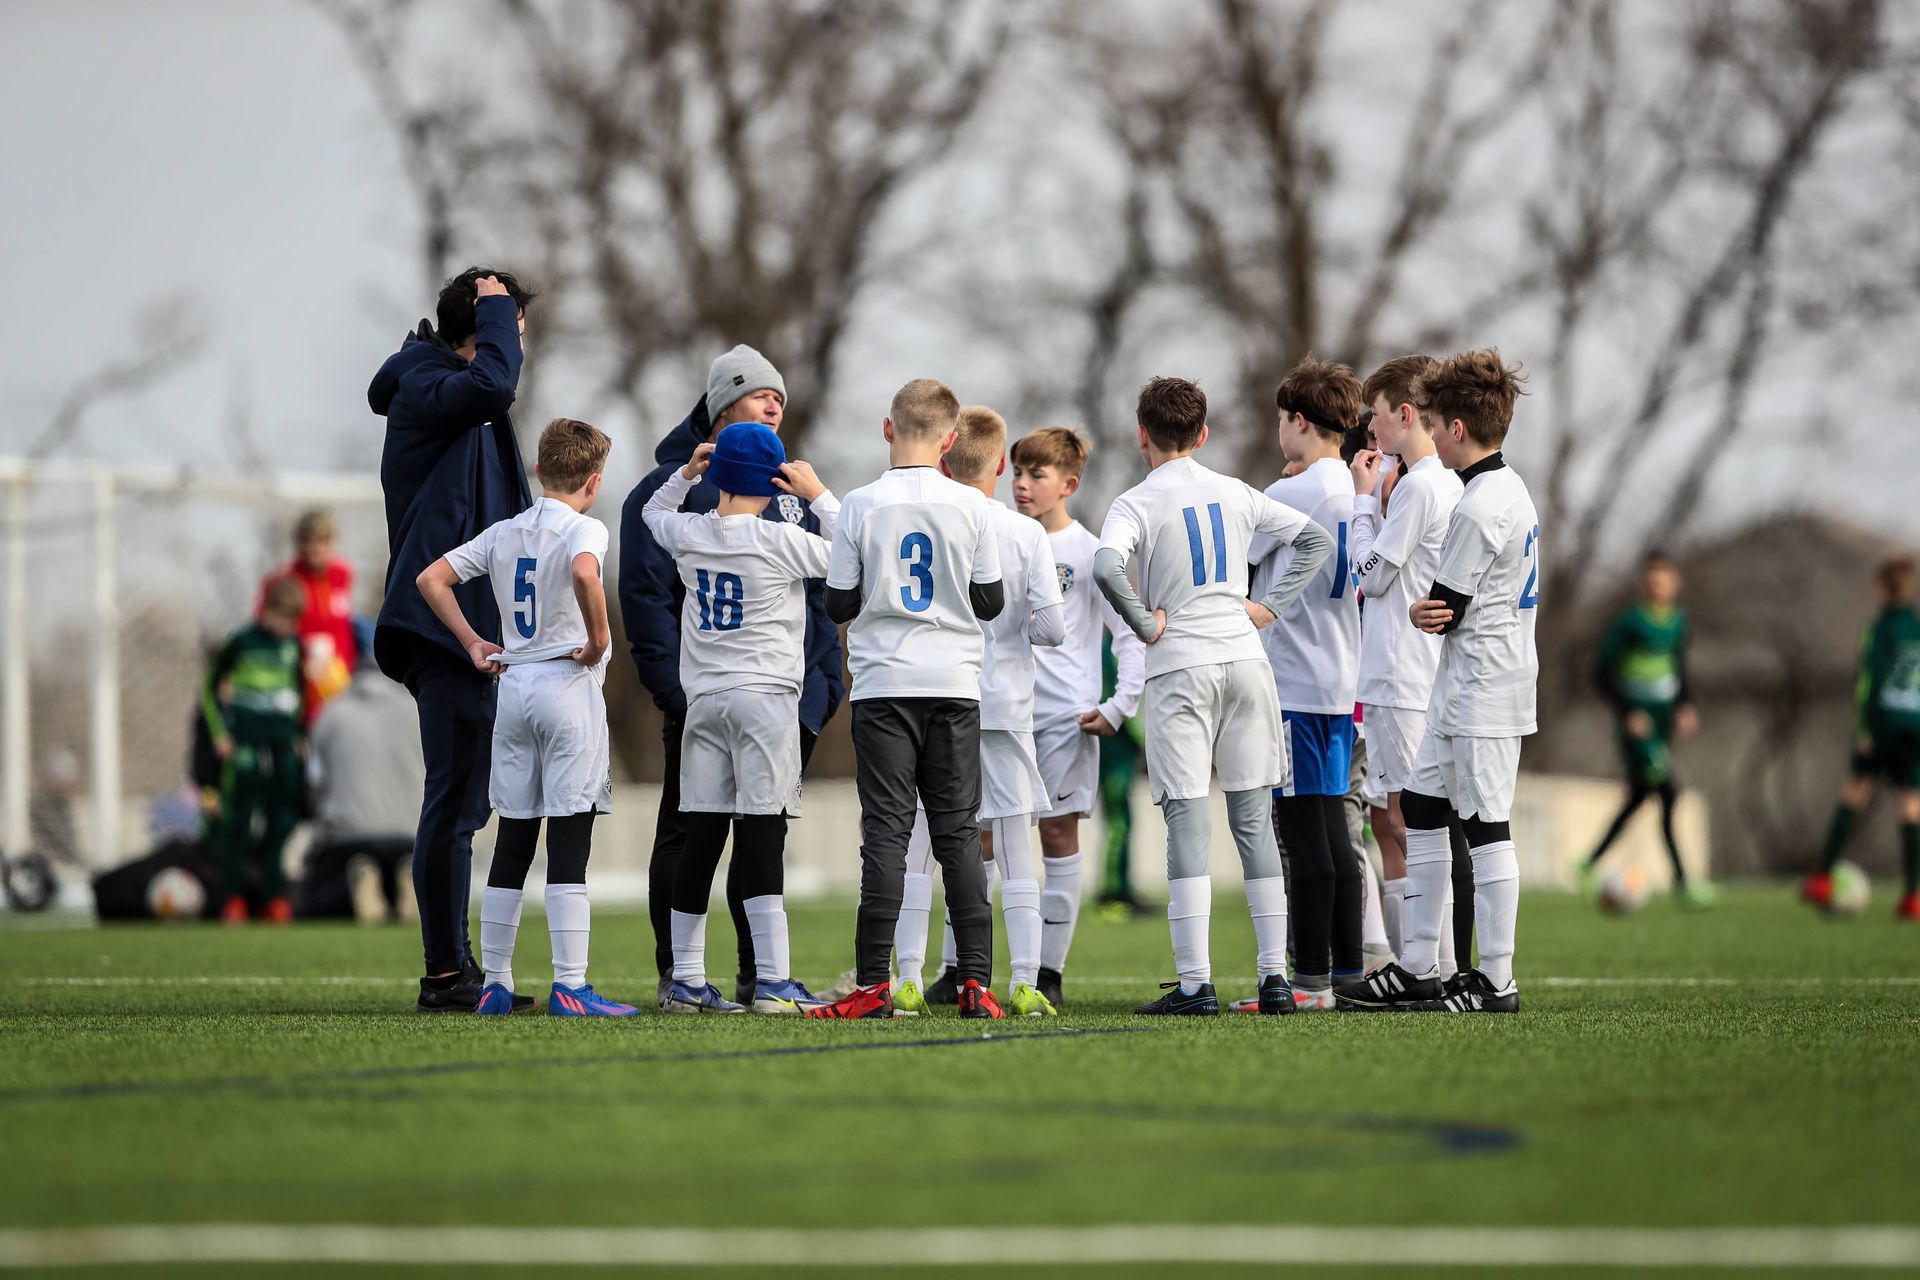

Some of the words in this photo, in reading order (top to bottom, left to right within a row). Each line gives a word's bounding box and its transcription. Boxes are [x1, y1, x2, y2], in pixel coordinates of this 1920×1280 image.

[900, 531, 934, 612] 3
[1182, 502, 1228, 587] 11
[514, 557, 538, 640] 5
[695, 568, 744, 631] 18
